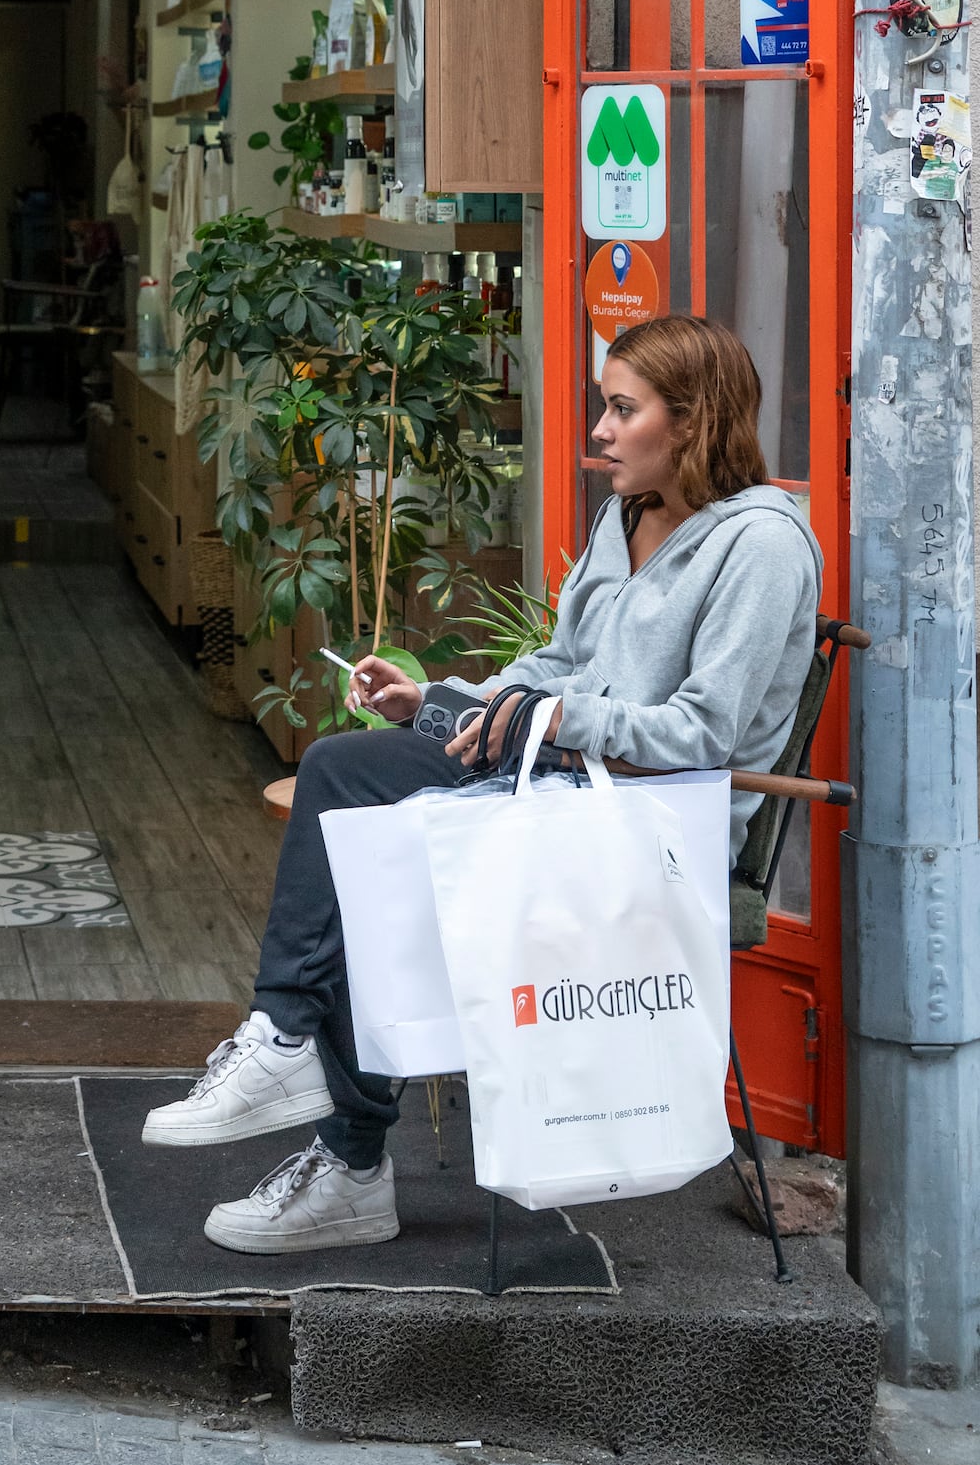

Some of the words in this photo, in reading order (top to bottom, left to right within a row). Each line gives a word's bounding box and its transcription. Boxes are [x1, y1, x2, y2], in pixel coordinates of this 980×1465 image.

[604, 169, 642, 181] multinet
[601, 292, 643, 306] Hepsipay
[592, 304, 623, 317] Burada
[542, 973, 695, 1021] GÜRGENÇLER
[545, 1112, 607, 1126] gurgencler.com.tr
[615, 1109, 632, 1119] 0850
[633, 1107, 647, 1116] 302
[648, 1105, 659, 1114] 85
[659, 1104, 670, 1113] 95
